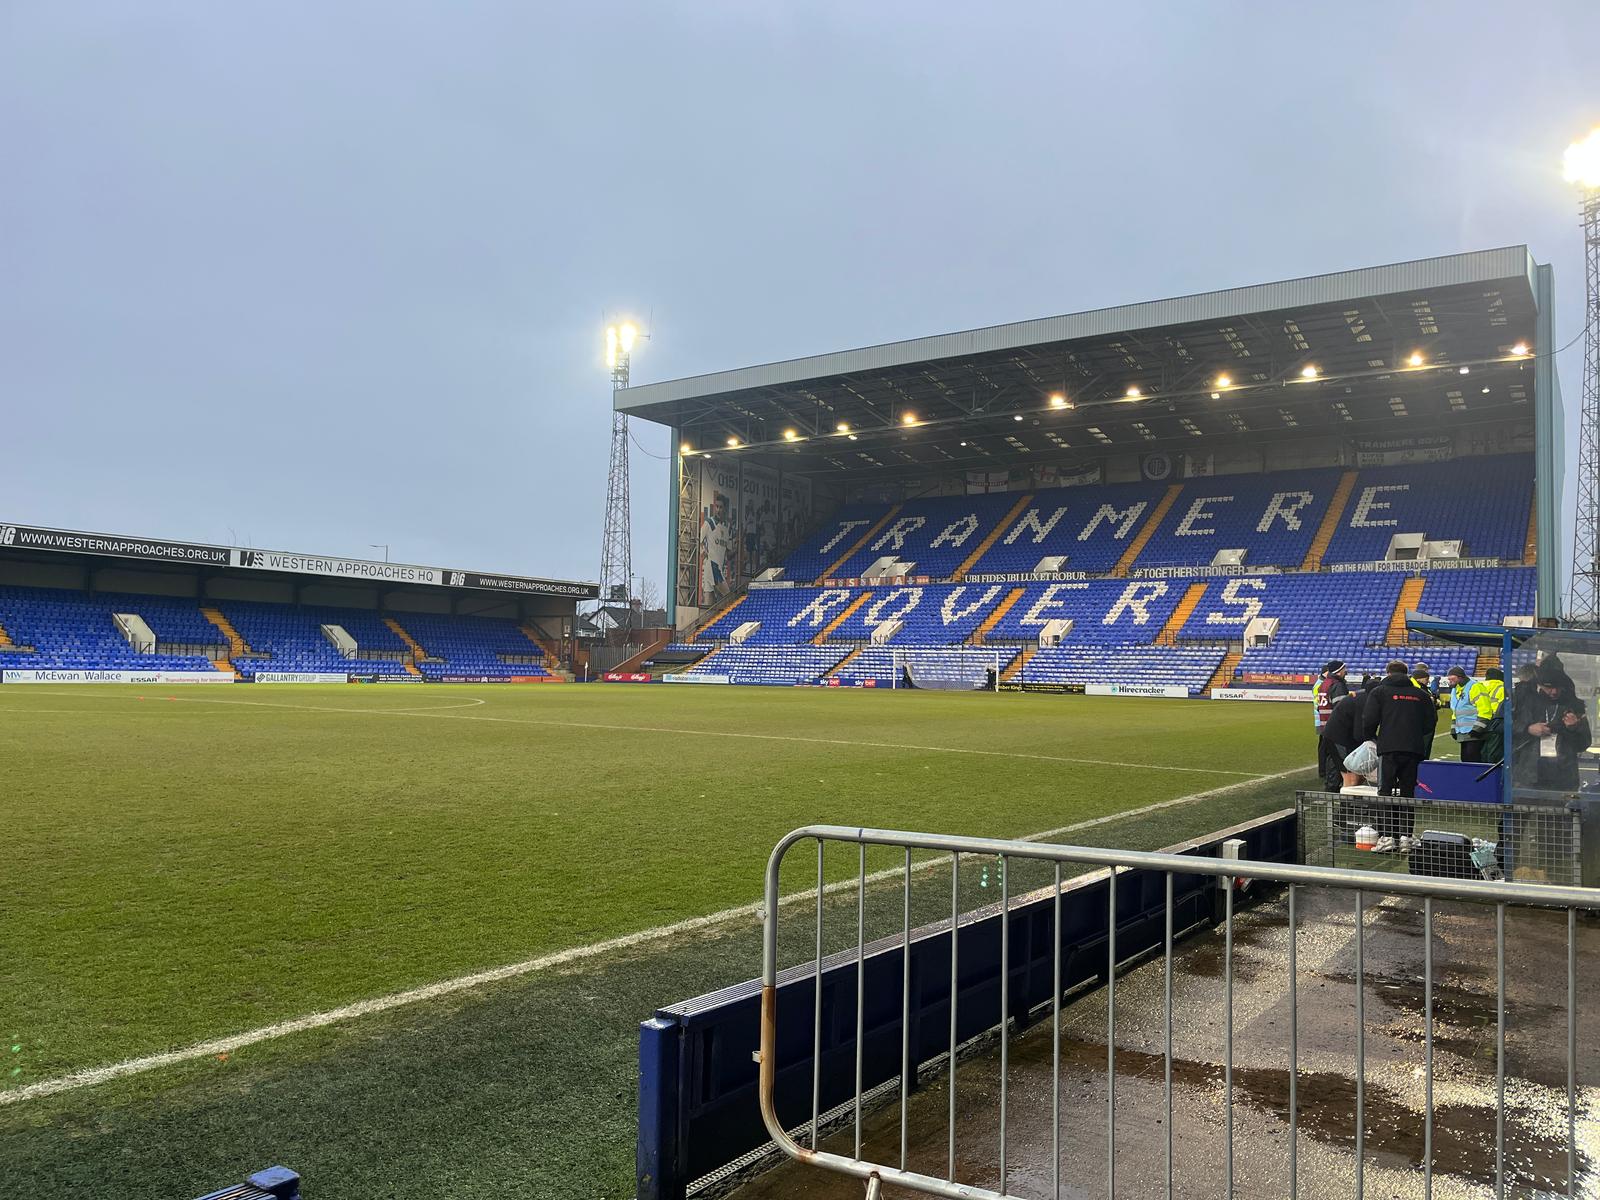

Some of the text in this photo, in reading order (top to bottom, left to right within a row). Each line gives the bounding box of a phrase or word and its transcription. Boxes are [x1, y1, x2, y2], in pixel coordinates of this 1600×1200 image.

[718, 472, 738, 491] 0151
[744, 479, 759, 496] 201
[762, 484, 778, 500] 1111
[819, 484, 1410, 554] TRANMERE
[0, 526, 226, 562] iG WWW.WESTERNAPPROACHES.ORG.UK
[269, 555, 434, 582] WESTERN APPROACHES HQ
[1331, 564, 1344, 573] FOR
[1345, 563, 1357, 572] THE
[1378, 561, 1428, 571] FOR THE BADGE
[1459, 560, 1473, 569] TILL
[1474, 559, 1486, 568] WE
[1486, 559, 1498, 568] DIE
[965, 571, 1087, 583] UBI FIDES IBI LUX ET ROBUR
[1133, 565, 1245, 579] #TOGETHERSTRONGER
[479, 578, 589, 595] WWW.WESTERNAPPROACHES.ORG.UK
[869, 577, 880, 586] W
[894, 577, 903, 586] A
[787, 578, 1267, 627] ROVERS
[35, 671, 79, 681] McEwan
[84, 671, 122, 681] Wallace
[265, 673, 298, 682] GALLANTRY
[865, 679, 875, 687] bet
[1118, 685, 1165, 694] Hirecracker
